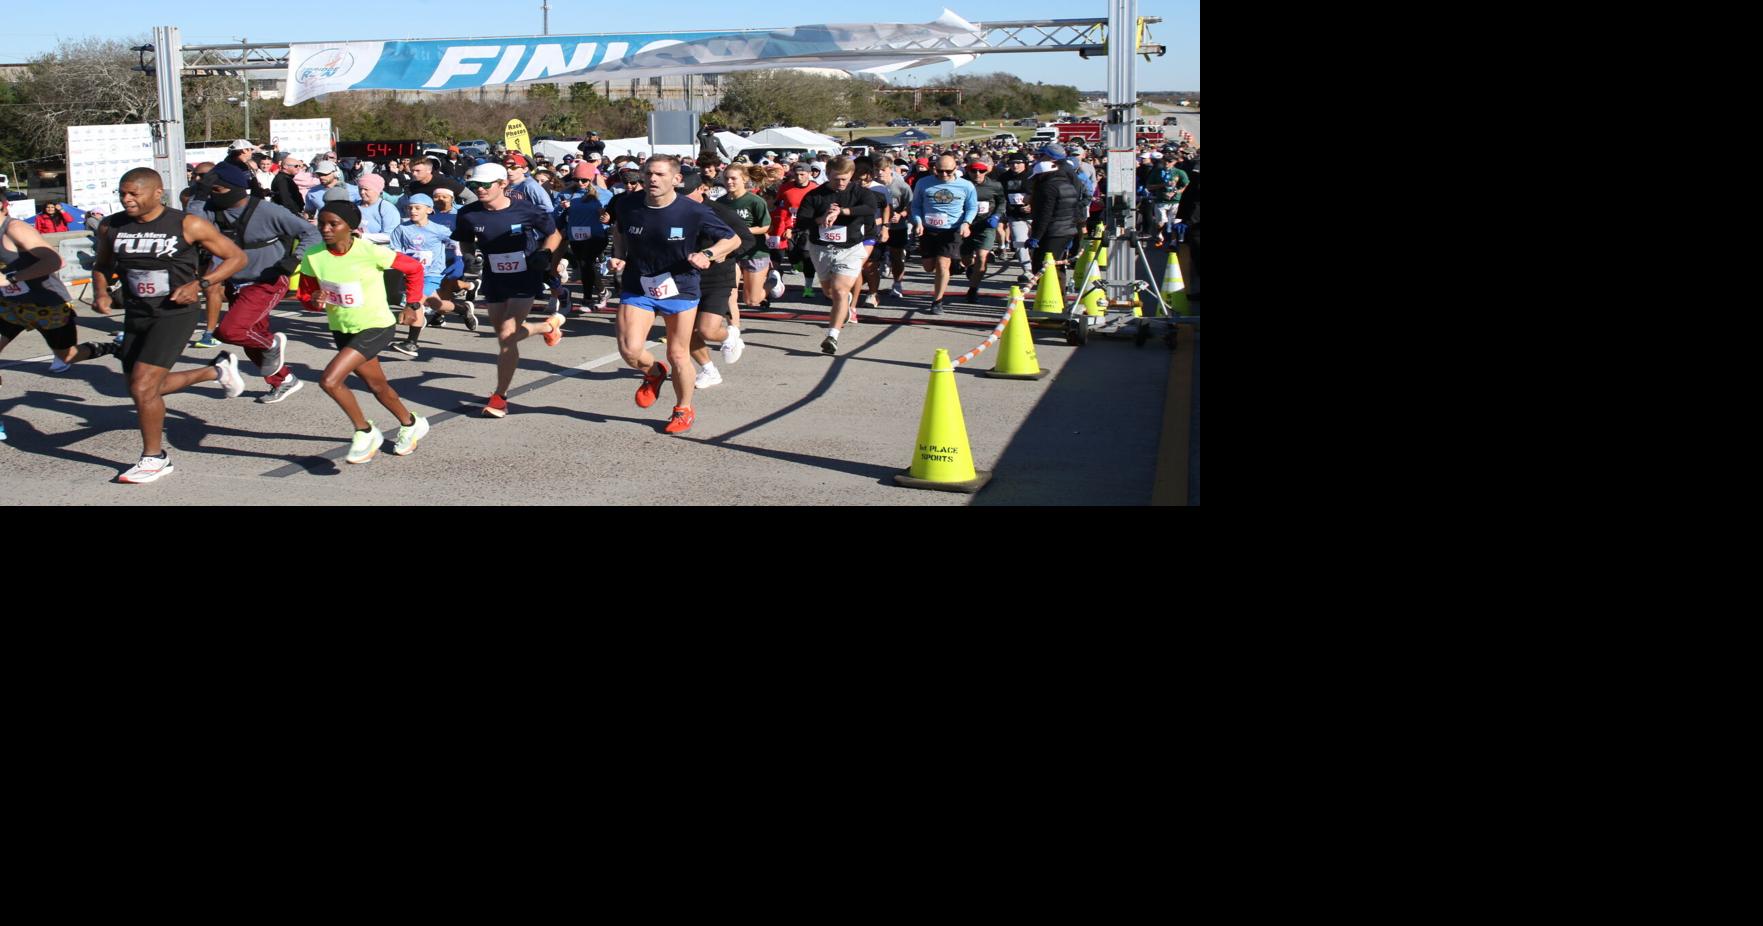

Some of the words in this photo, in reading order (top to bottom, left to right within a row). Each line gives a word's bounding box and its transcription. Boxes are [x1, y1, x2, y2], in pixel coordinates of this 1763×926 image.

[506, 129, 526, 137] Photos
[824, 232, 841, 241] 355
[496, 261, 519, 271] 537
[137, 282, 155, 294] 65
[648, 284, 668, 297] 587
[329, 291, 354, 304] 515
[929, 445, 958, 454] PLACE
[921, 453, 953, 462] SPORTS
